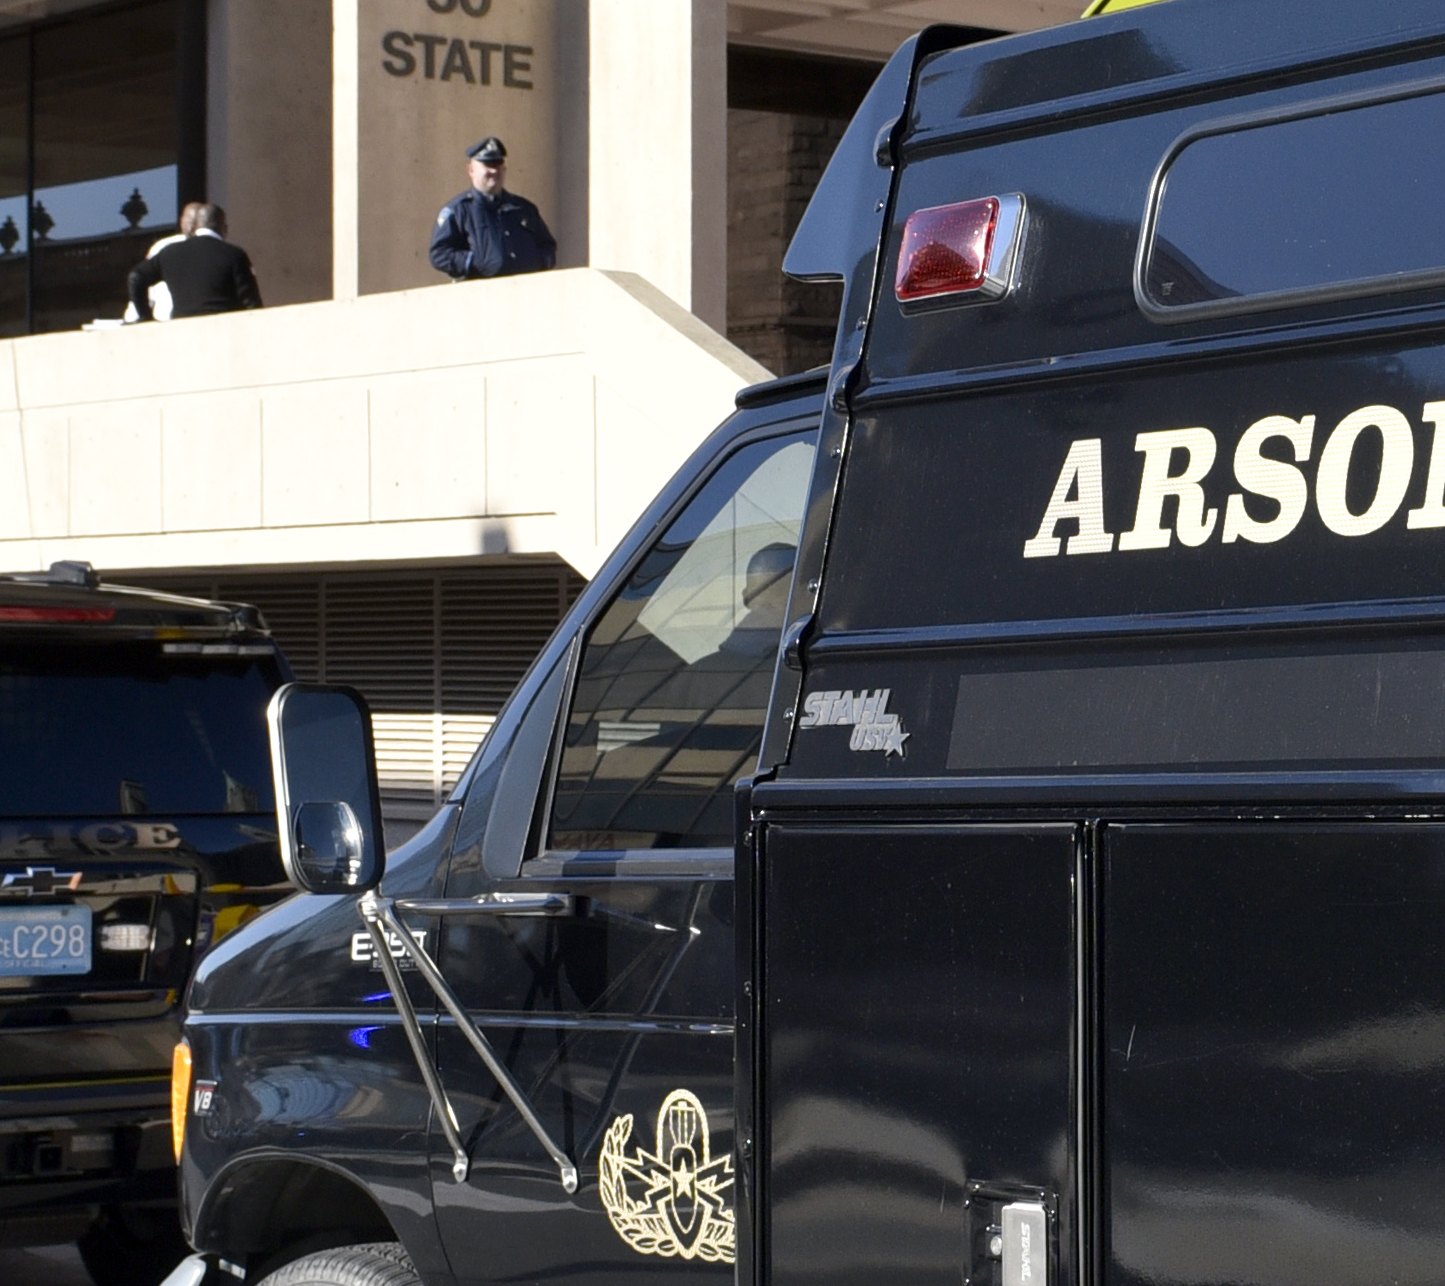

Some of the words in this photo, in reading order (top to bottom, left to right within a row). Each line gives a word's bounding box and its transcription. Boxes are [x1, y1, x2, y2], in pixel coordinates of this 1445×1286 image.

[382, 30, 534, 90] STATE
[799, 688, 898, 729] STAHL
[13, 924, 85, 959] C298
[195, 1090, 213, 1113] V8
